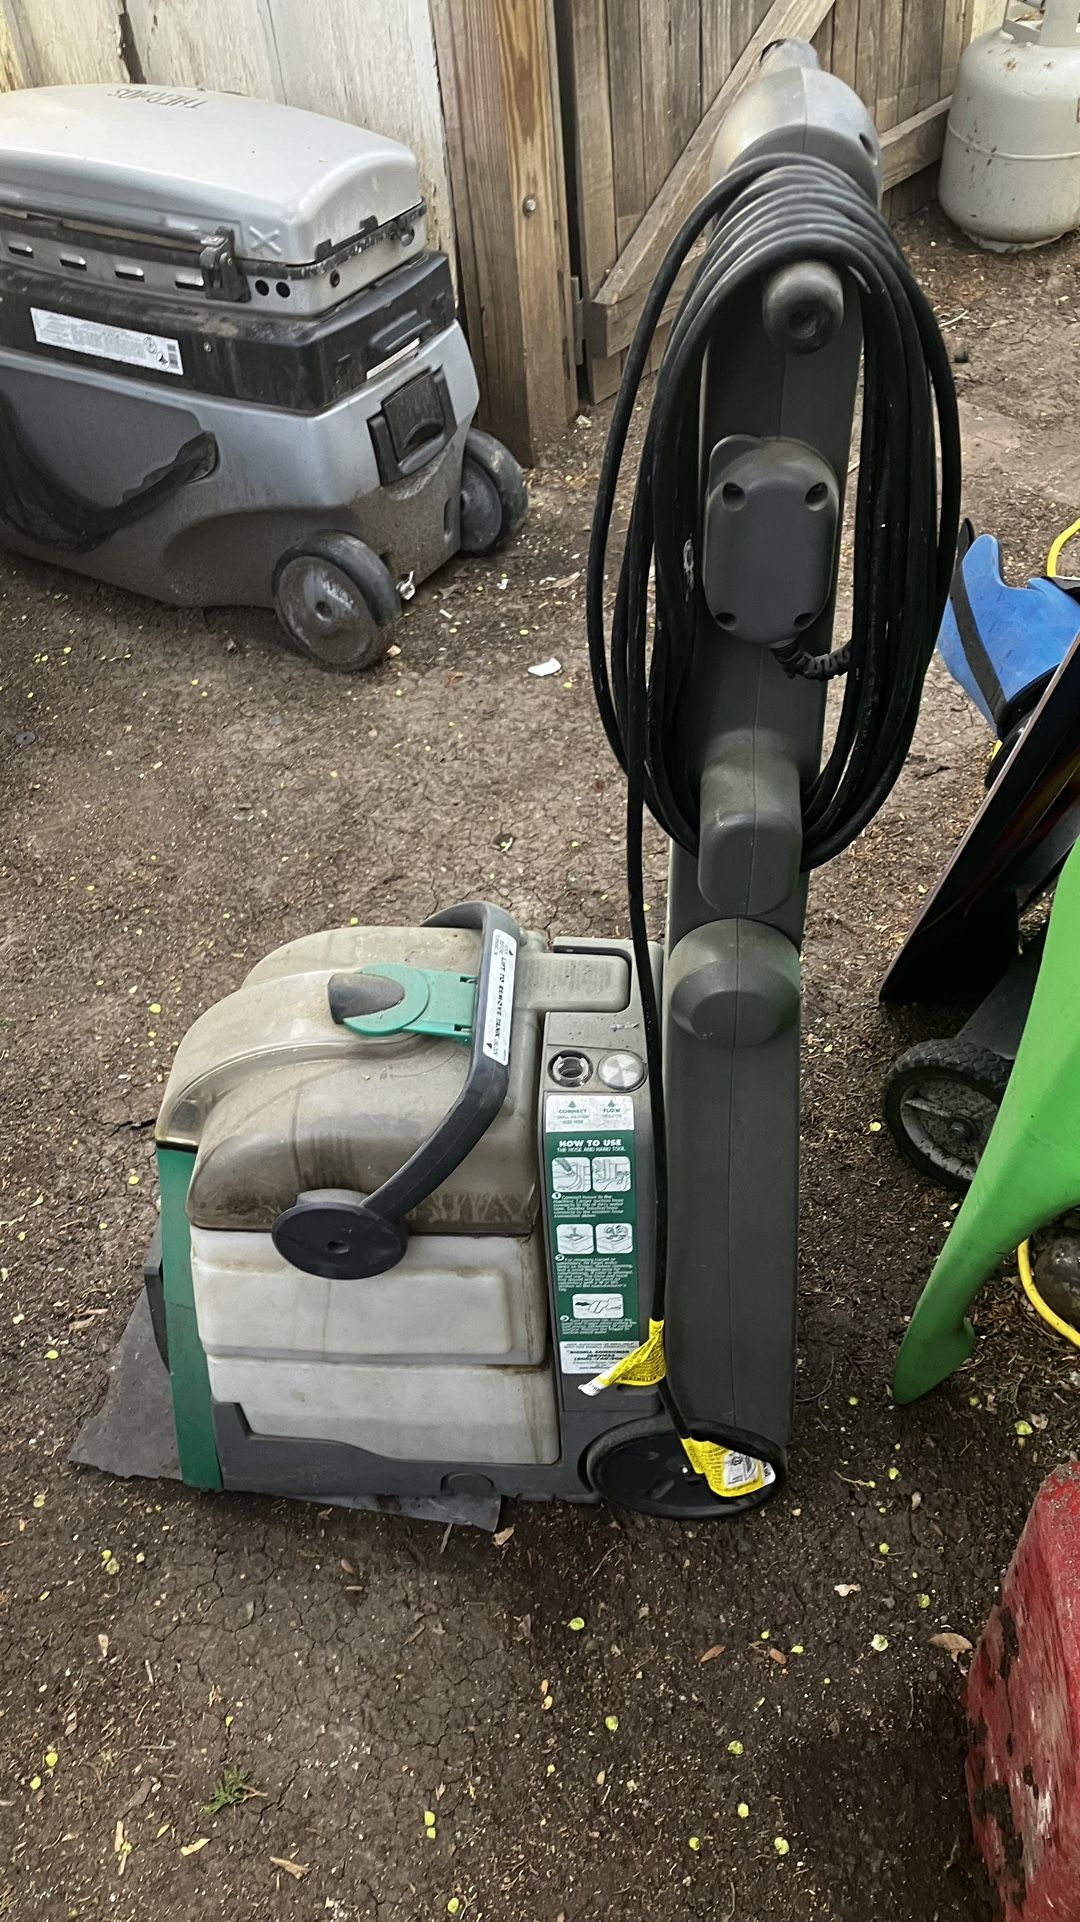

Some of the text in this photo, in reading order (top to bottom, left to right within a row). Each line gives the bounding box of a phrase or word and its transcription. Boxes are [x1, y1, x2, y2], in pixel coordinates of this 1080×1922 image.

[558, 1138, 622, 1148] HOW TO USE
